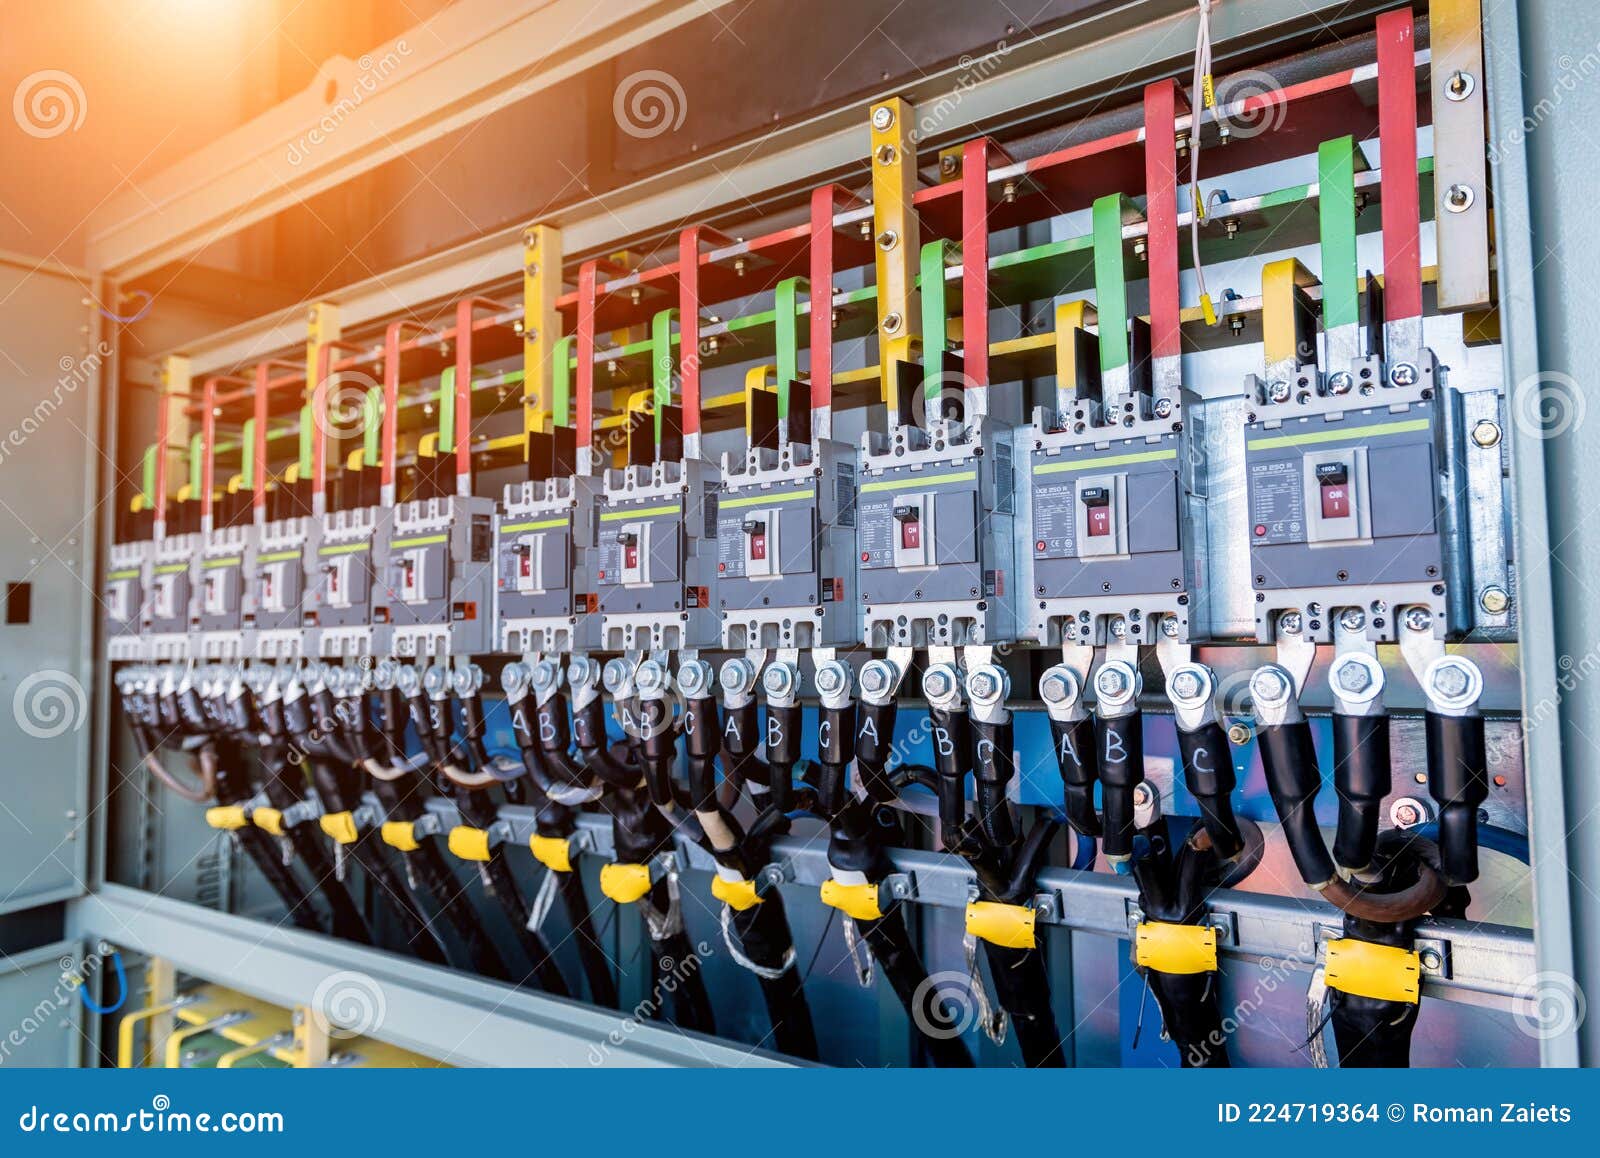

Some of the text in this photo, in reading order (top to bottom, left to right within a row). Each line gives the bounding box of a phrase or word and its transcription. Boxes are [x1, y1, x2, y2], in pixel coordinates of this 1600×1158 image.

[1329, 490, 1343, 499] ON
[512, 709, 531, 737] A
[539, 712, 556, 742] B
[622, 708, 637, 731] A
[640, 712, 653, 741] B
[684, 711, 696, 735] C
[724, 715, 741, 741] A
[768, 716, 783, 747] B
[859, 716, 879, 746] A
[819, 720, 831, 748] C
[935, 727, 954, 756] B
[1105, 728, 1128, 763] B
[977, 739, 994, 764] C
[1060, 732, 1082, 767] A
[1192, 747, 1215, 773] C
